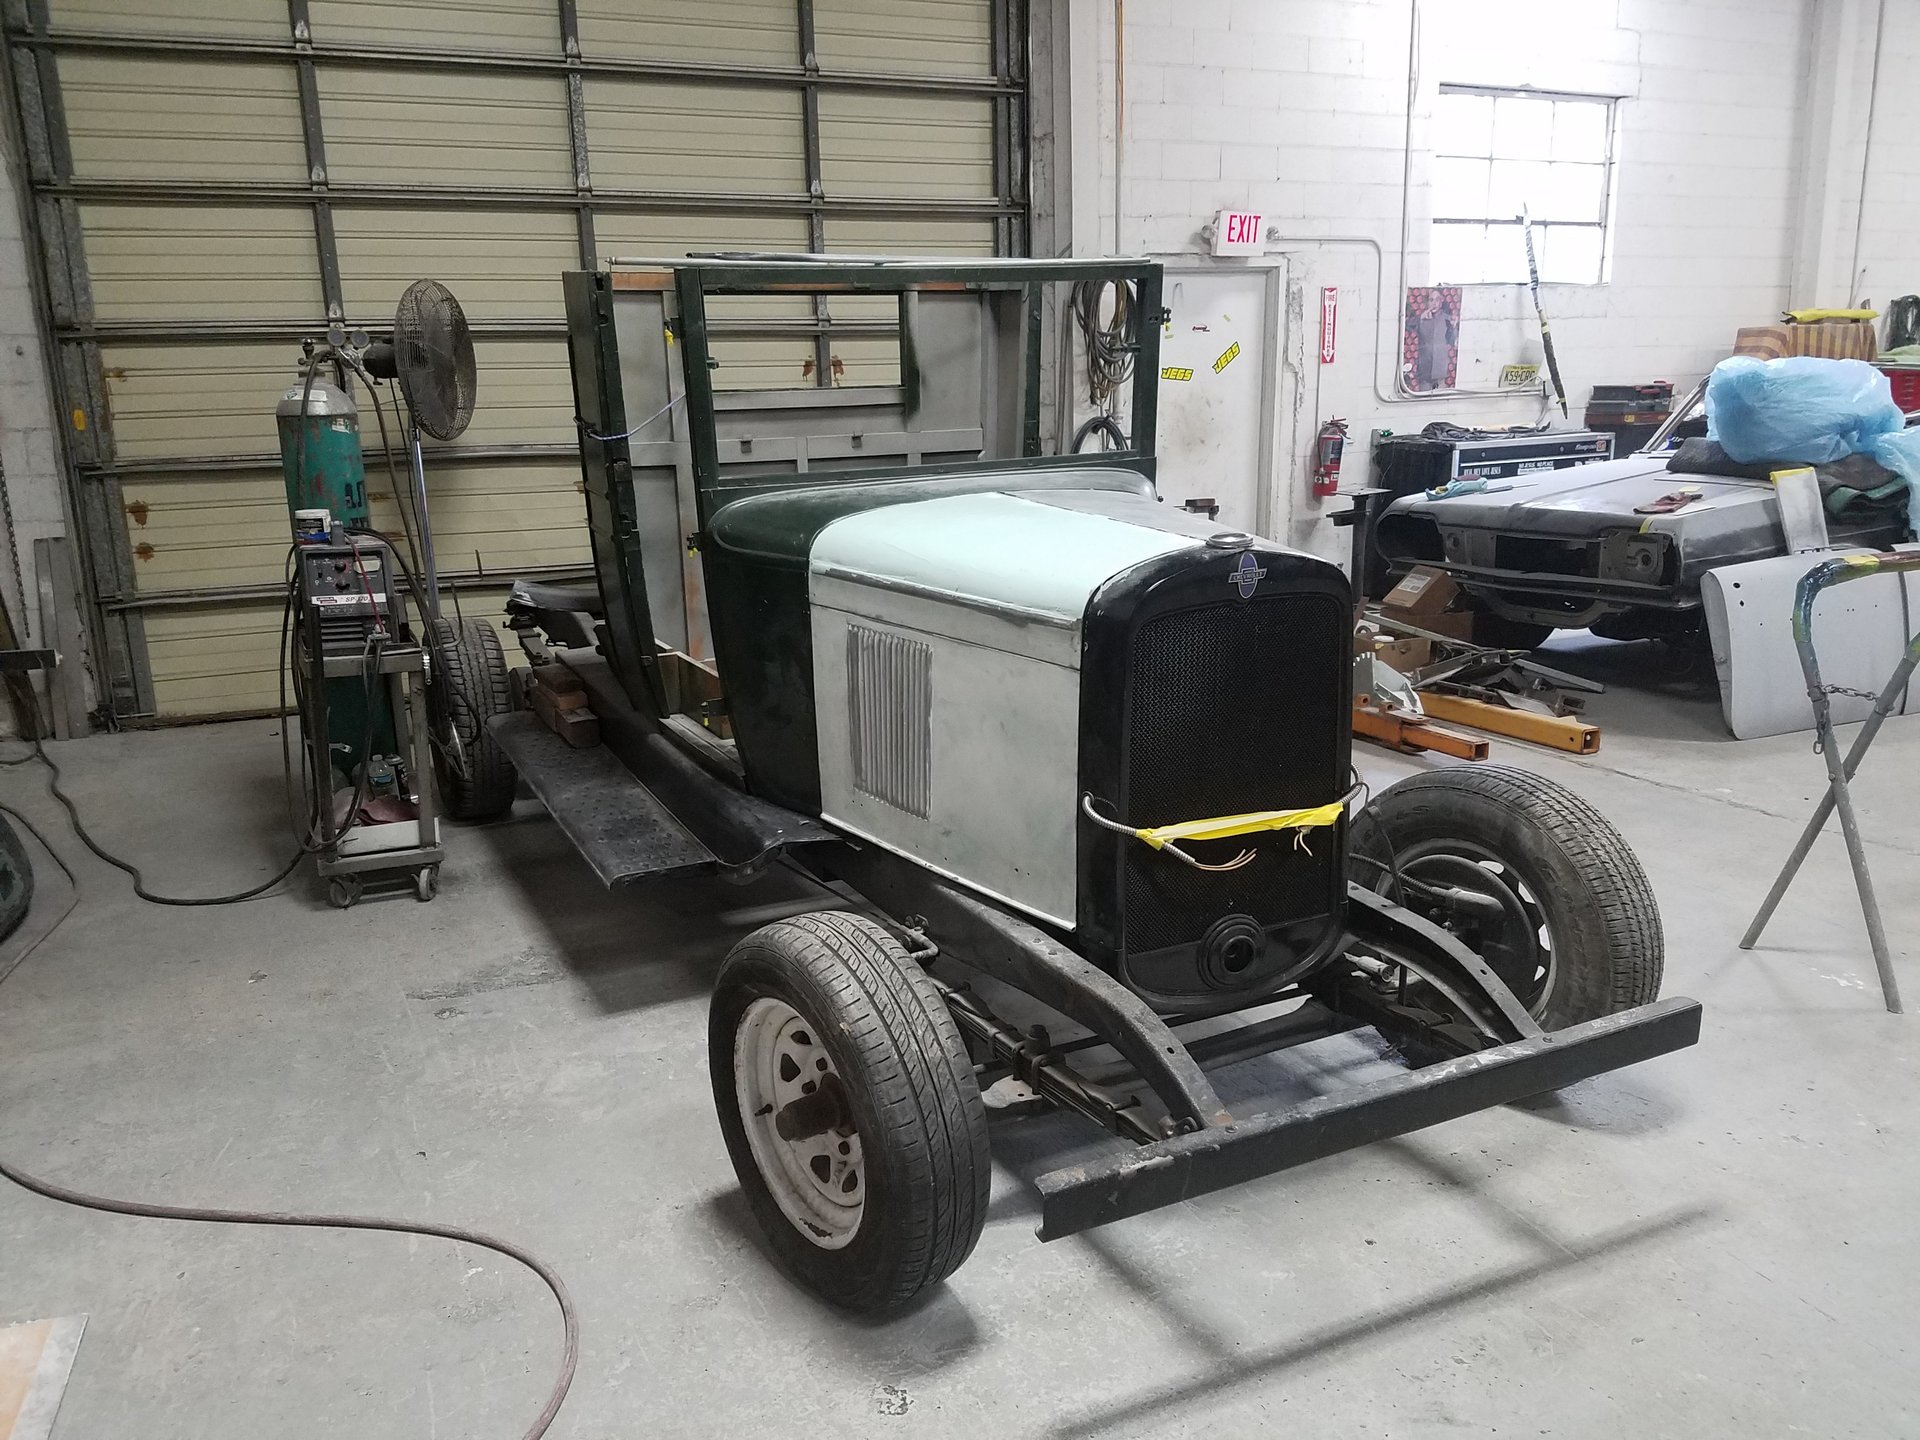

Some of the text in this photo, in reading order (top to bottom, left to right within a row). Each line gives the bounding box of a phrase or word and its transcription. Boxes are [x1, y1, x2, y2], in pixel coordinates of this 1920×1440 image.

[1227, 214, 1262, 243] EXIT
[1325, 294, 1336, 302] FIRE
[1212, 341, 1241, 375] JEGS
[1161, 367, 1194, 382] JEGS
